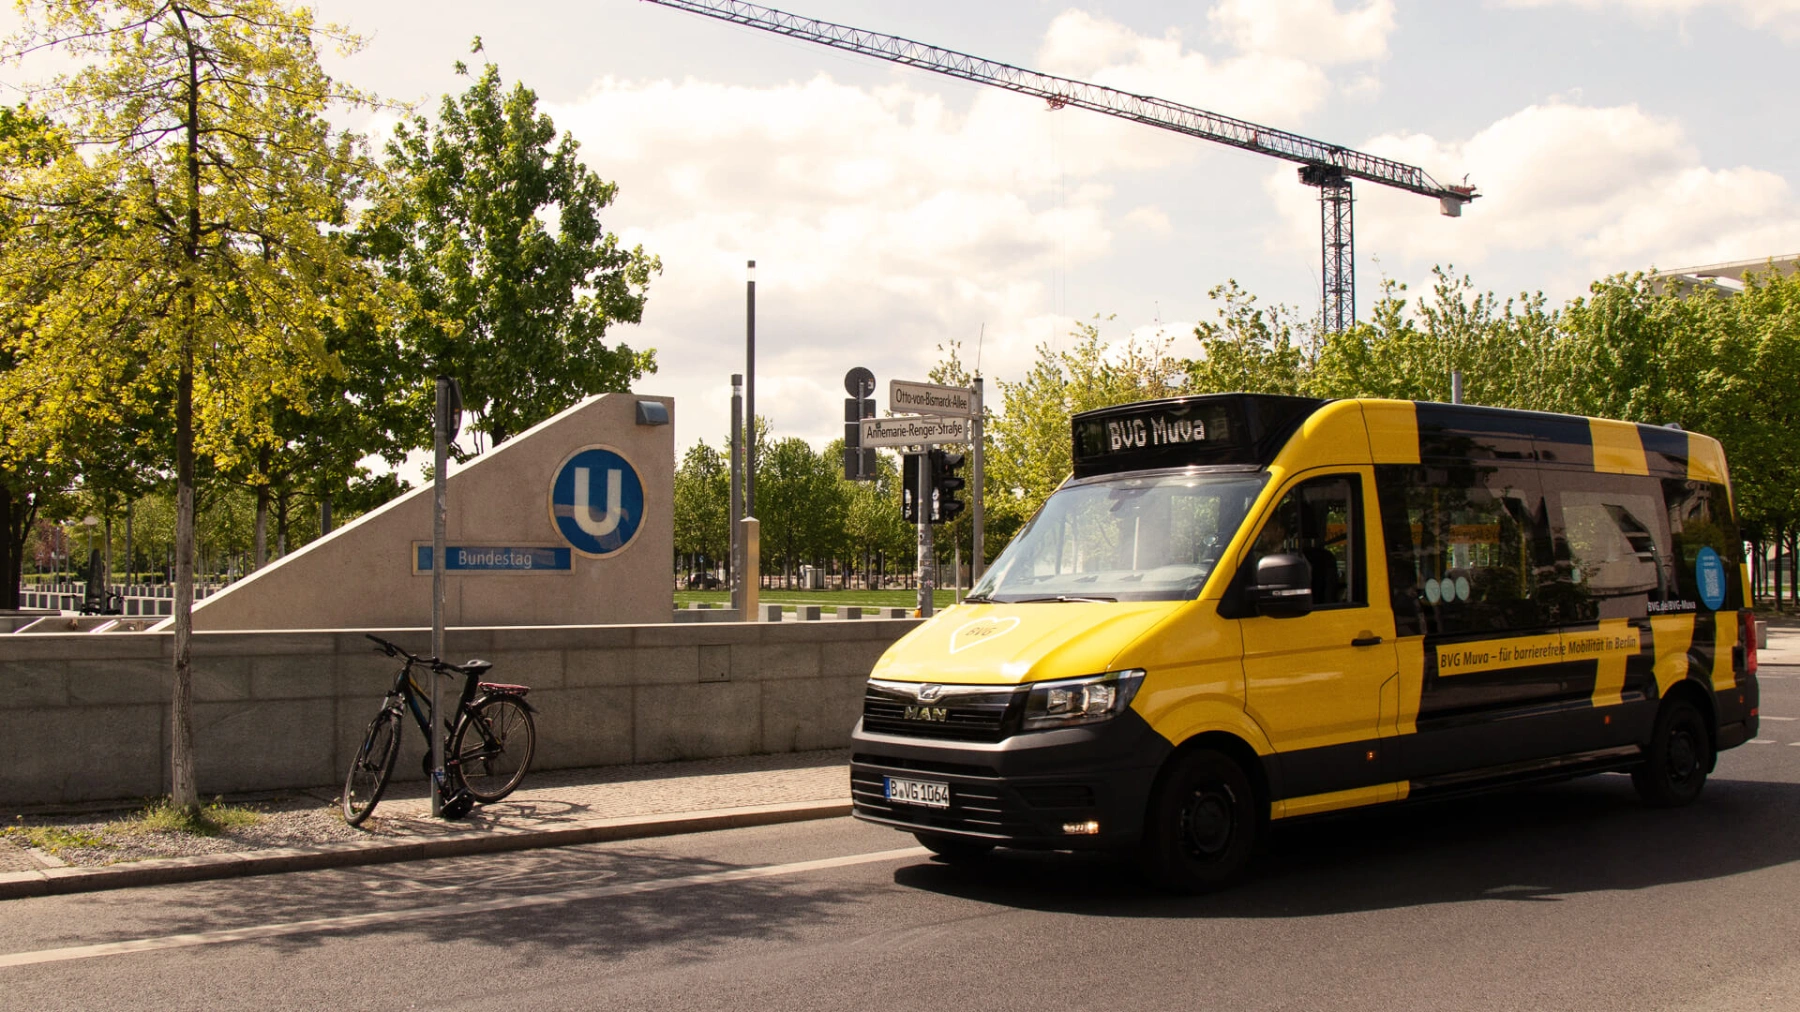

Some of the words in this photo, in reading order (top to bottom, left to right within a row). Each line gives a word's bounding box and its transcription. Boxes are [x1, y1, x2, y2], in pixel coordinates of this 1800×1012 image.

[895, 388, 968, 409] Otto-von-Bismarck-Allee
[866, 420, 963, 438] Annemarie-Renger-Straße
[1109, 419, 1147, 450] BVG
[1150, 415, 1205, 445] Muva
[574, 467, 622, 536] U
[458, 550, 533, 569] Bundestag
[965, 626, 997, 636] BVG
[1440, 652, 1461, 668] BVG
[1463, 651, 1489, 666] Muva
[1499, 647, 1512, 662] für
[1514, 643, 1566, 660] barrierefreie
[1568, 638, 1604, 655] Mobilität
[1606, 637, 1613, 651] in
[1615, 635, 1636, 650] Berlin
[904, 706, 947, 721] MAN
[920, 785, 948, 804] 1064
